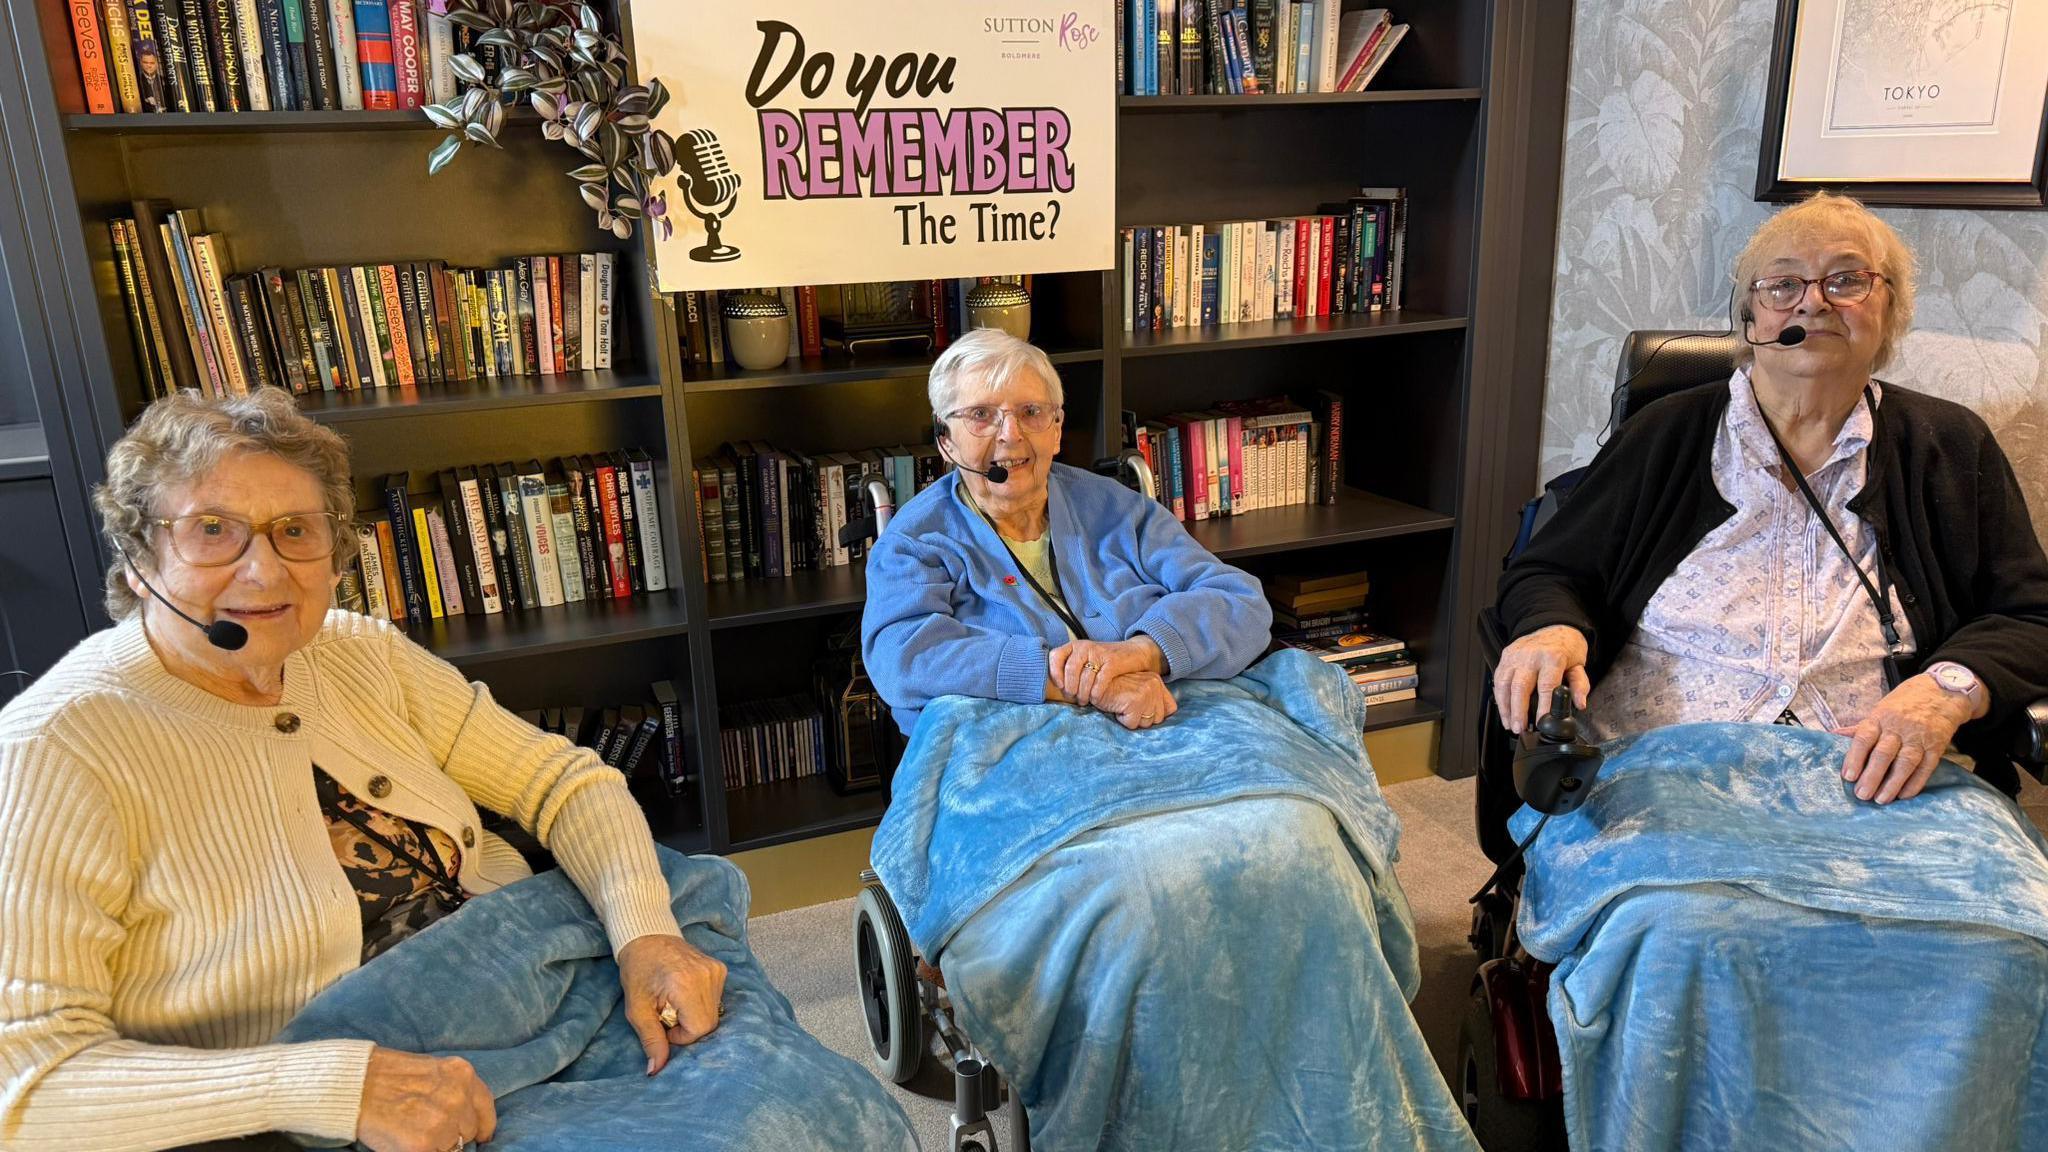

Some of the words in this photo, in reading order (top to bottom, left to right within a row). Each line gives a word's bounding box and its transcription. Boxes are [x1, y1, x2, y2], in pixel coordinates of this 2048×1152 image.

[135, 9, 154, 40] DEE
[167, 17, 179, 42] Dear
[400, 2, 413, 32] MAY
[984, 17, 1054, 33] SUTTON
[1059, 11, 1100, 53] Rose
[1238, 20, 1254, 73] German
[164, 48, 177, 85] REPORTS
[171, 45, 187, 63] Bill
[187, 20, 209, 85] MONTGOMERIE
[221, 32, 240, 85] SIMPSON
[403, 35, 419, 93] COOPER
[1001, 52, 1040, 60] BOLDMERE
[85, 72, 93, 87] TIDE
[91, 67, 101, 91] RISING
[319, 69, 327, 89] TODAY
[745, 20, 836, 108] Do
[845, 51, 958, 121] you
[1884, 84, 1940, 101] TOKYO
[757, 106, 1075, 200] REMEMBER
[894, 201, 957, 246] The
[970, 200, 1061, 243] Time?
[518, 261, 527, 280] Alex
[1282, 248, 1292, 278] Reichs
[401, 272, 414, 311] Griffiths
[416, 271, 429, 310] Griffiths
[519, 281, 529, 303] Gray
[600, 264, 609, 300] Doughnut
[375, 300, 383, 323] VINEGAR
[381, 269, 393, 294] Ann
[387, 296, 404, 345] Cleeves
[239, 291, 247, 303] THE
[243, 304, 255, 333] NATURAL
[250, 334, 260, 357] WORLD
[493, 310, 509, 348] SAIL
[523, 319, 531, 332] THE
[601, 319, 609, 335] Tom
[299, 328, 310, 350] NIGHT
[524, 334, 534, 363] STALKER
[600, 338, 608, 354] Holt
[1330, 427, 1340, 460] NORMAN
[604, 473, 615, 499] CHRIS
[618, 472, 629, 494] ROGUE
[391, 493, 400, 513] ALAN
[467, 487, 480, 515] FIRE
[492, 494, 500, 514] STELLA
[621, 495, 632, 520] TRADER
[473, 518, 487, 543] AND
[608, 501, 621, 535] MOYLES
[395, 516, 407, 554] WHICKER
[536, 524, 549, 555] VOICES
[369, 552, 378, 576] JAMES
[479, 546, 493, 575] FURY
[342, 576, 352, 596] Hello
[361, 544, 373, 586] PATTERSON
[368, 588, 378, 610] BLINK
[663, 707, 674, 738] GERRITSEN
[607, 738, 625, 766] CUSSLE
[626, 737, 648, 769] CUSSLER
